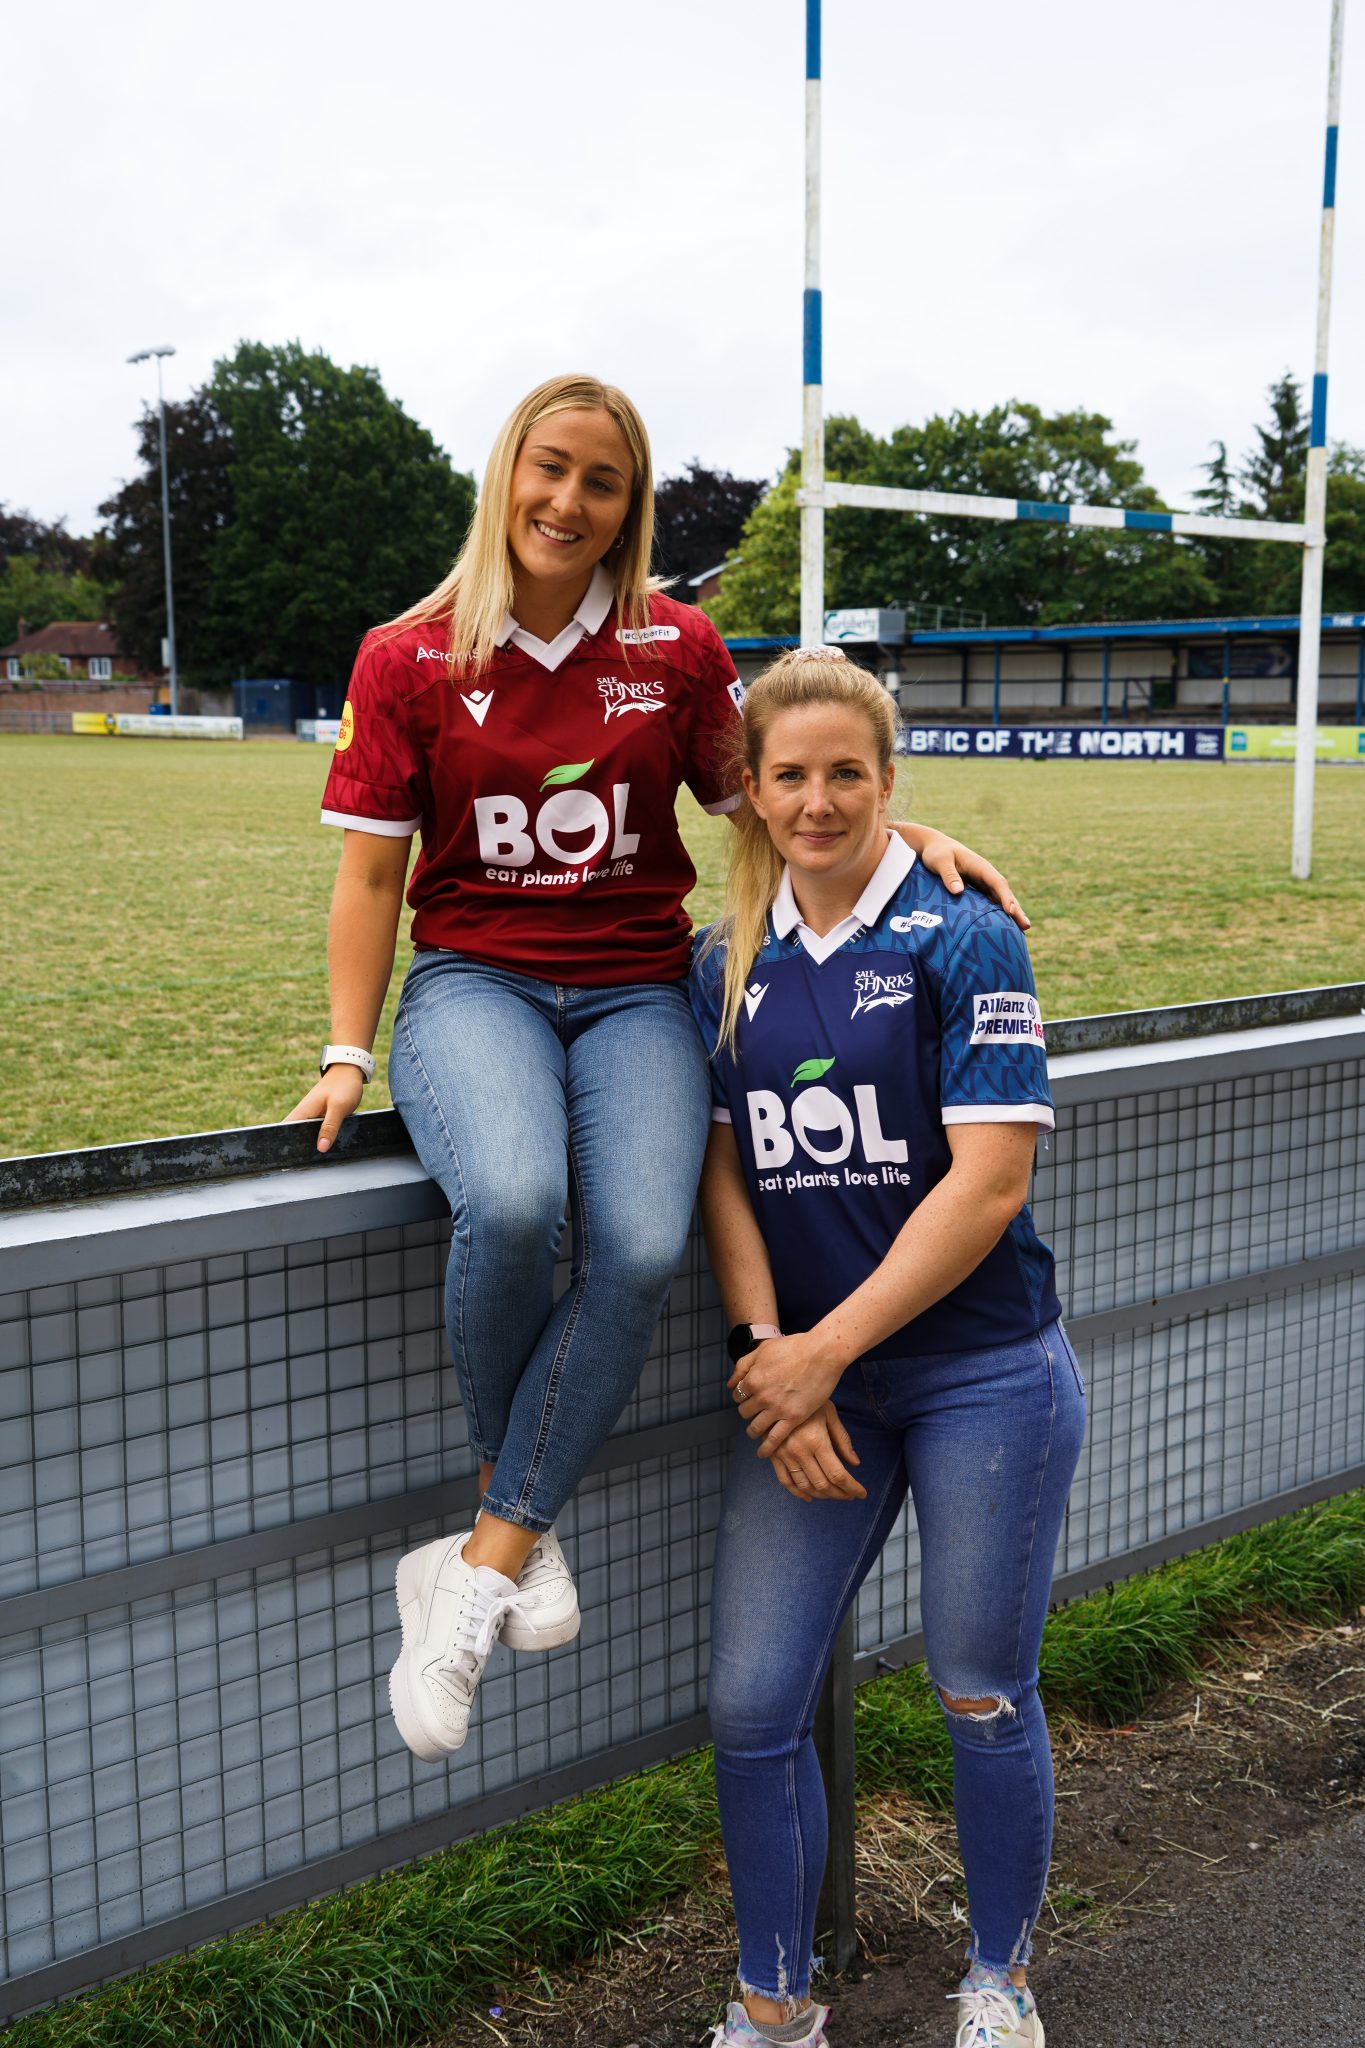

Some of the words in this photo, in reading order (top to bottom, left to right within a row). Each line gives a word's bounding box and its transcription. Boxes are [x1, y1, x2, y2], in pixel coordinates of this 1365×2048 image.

[597, 676, 618, 685] SALE
[895, 730, 970, 753] BRIC
[976, 730, 1011, 753] OF
[1018, 731, 1072, 754] THE
[1078, 731, 1185, 756] NORTH
[474, 783, 640, 867] BOL
[485, 868, 519, 883] eat
[521, 869, 579, 888] plants
[582, 866, 610, 883] love
[611, 859, 634, 877] life
[855, 969, 876, 979] SALE
[978, 997, 1025, 1015] Allianz
[747, 1084, 909, 1170] BOL
[785, 1170, 840, 1194] plants
[844, 1167, 878, 1186] love
[881, 1166, 911, 1186] life
